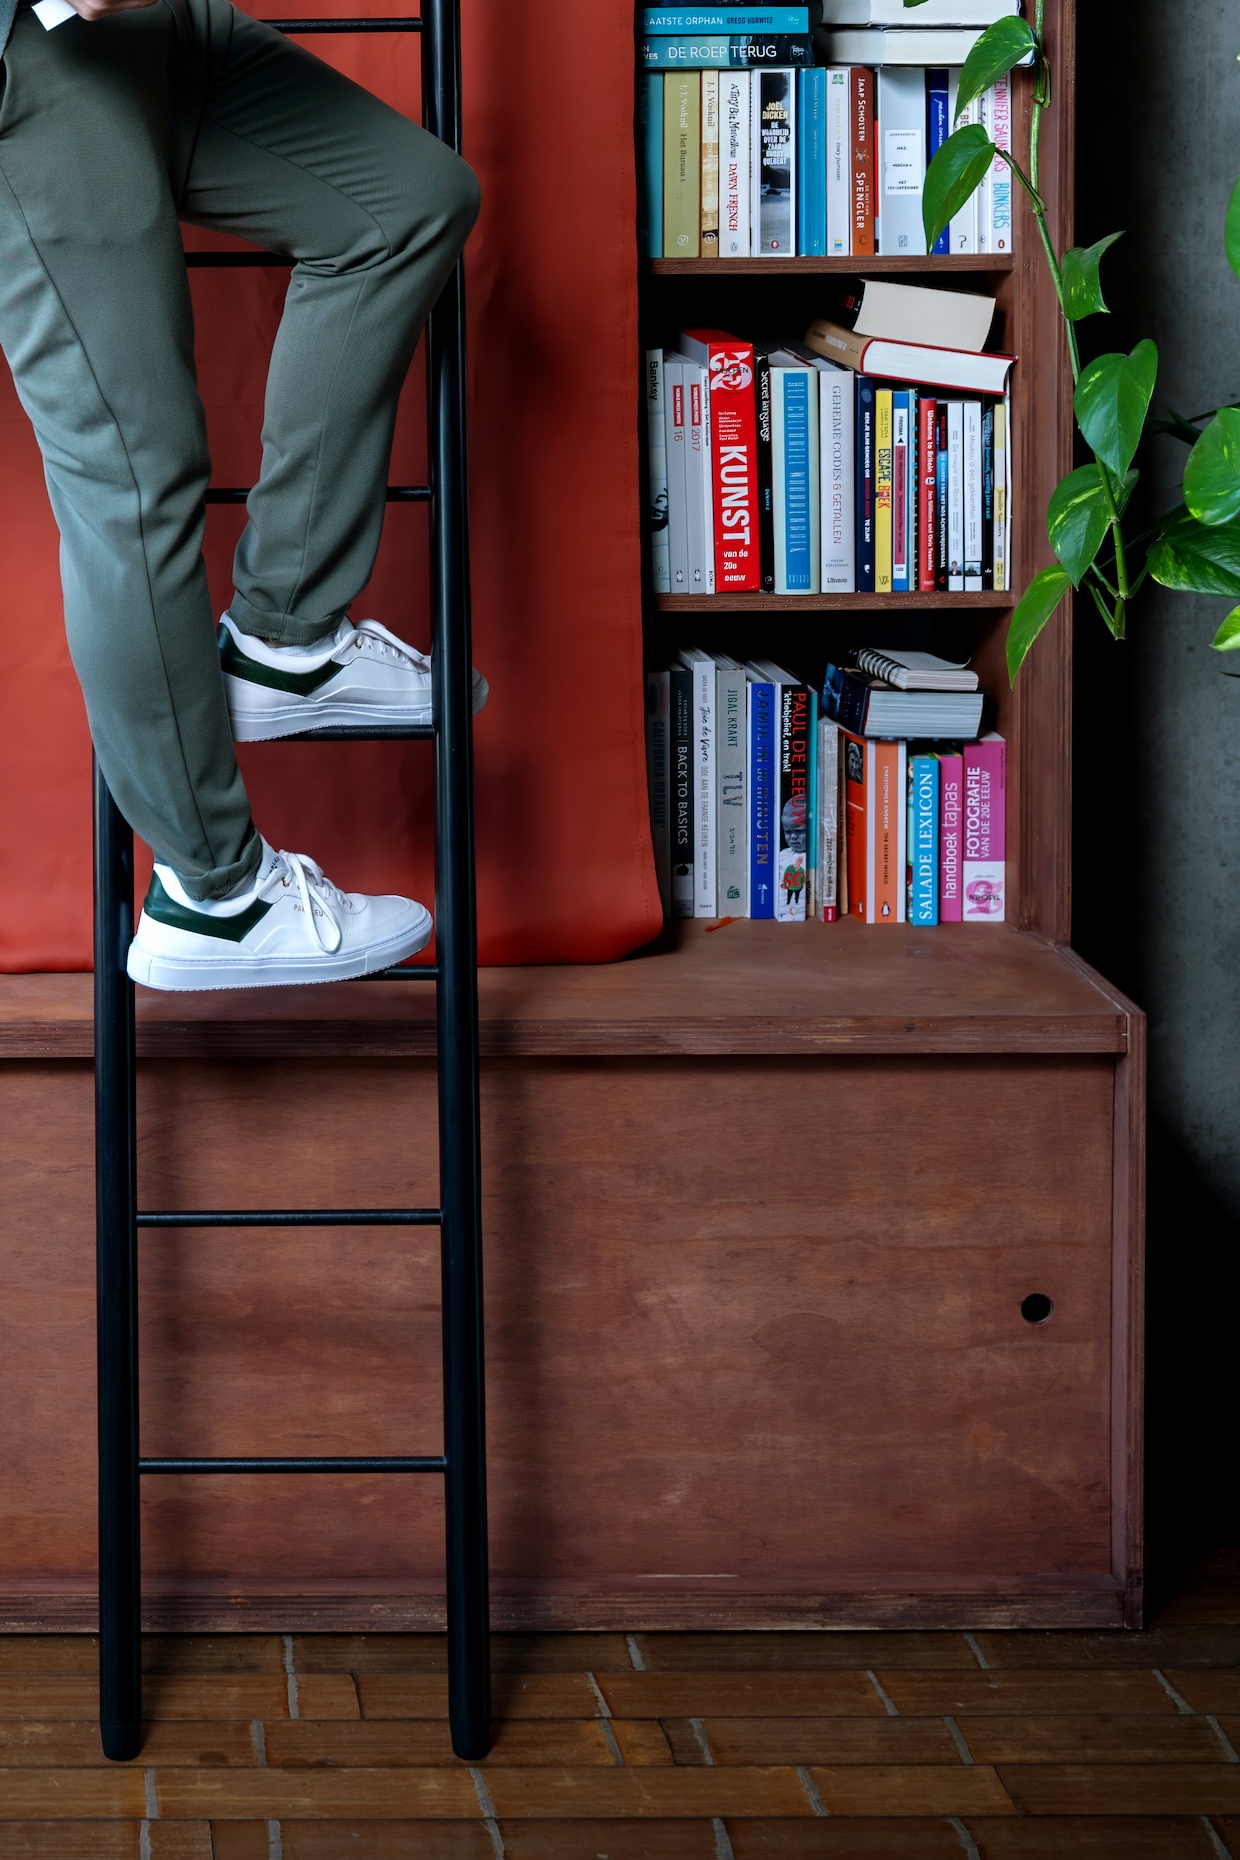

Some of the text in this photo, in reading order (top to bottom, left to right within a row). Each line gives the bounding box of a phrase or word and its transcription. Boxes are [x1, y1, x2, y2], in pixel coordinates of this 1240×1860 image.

[669, 46, 777, 58] DE ROEP TERUG
[650, 361, 658, 400] Banksy
[720, 445, 749, 544] KUNST
[919, 773, 932, 920] SALADE LEXICON
[942, 782, 961, 899] handboek tapas
[967, 766, 980, 858] FOTOGRAFIE
